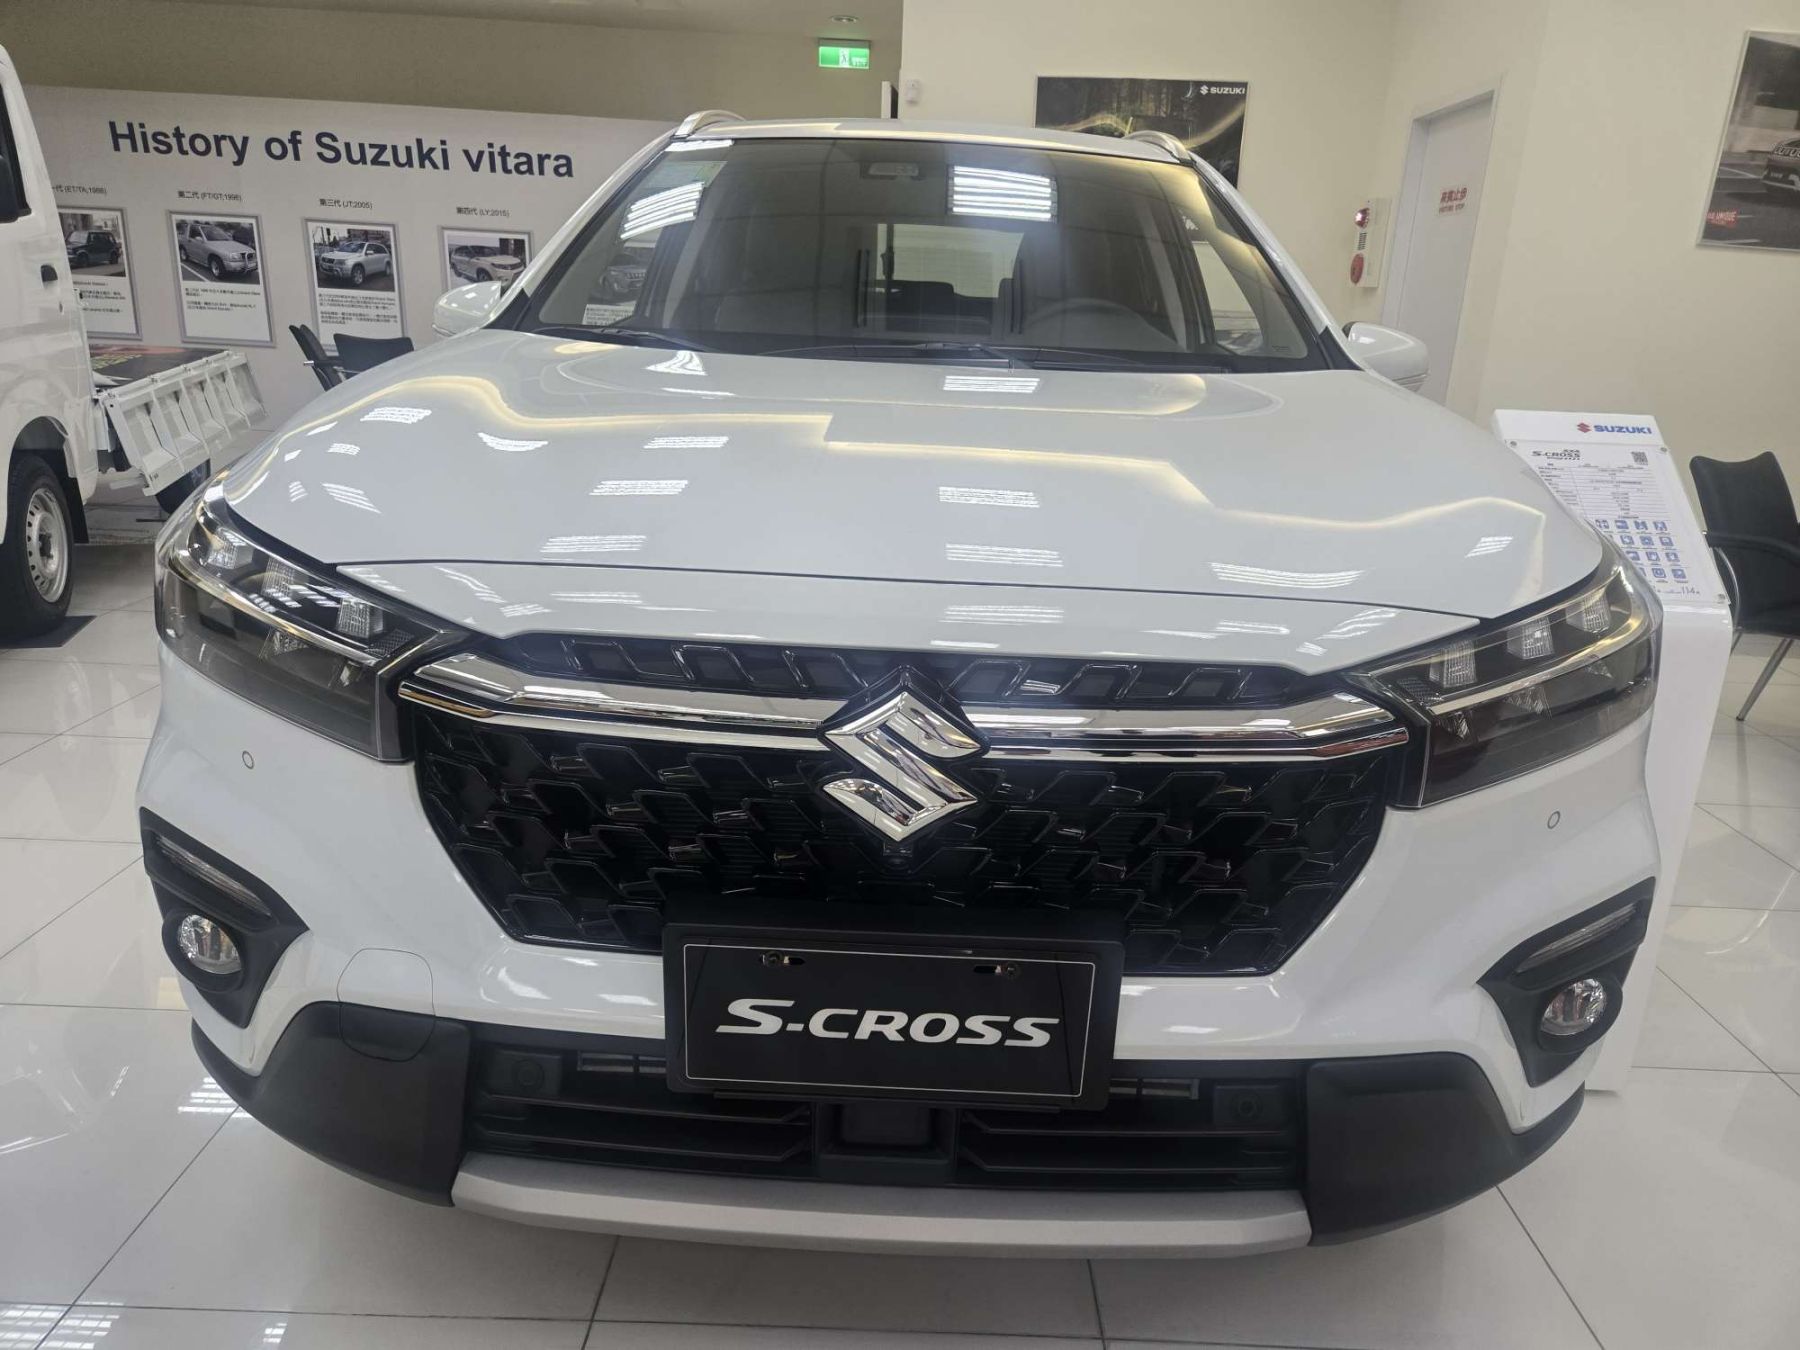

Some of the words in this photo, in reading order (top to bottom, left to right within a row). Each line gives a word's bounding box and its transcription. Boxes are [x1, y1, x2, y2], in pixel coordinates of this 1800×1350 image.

[1210, 86, 1245, 95] SUZUKI
[109, 121, 249, 166] History
[264, 130, 302, 162] of
[315, 131, 450, 171] Suzuki
[462, 142, 574, 178] vitara
[1593, 425, 1652, 435] SUZUKI
[715, 998, 1060, 1048] S-CROSS
